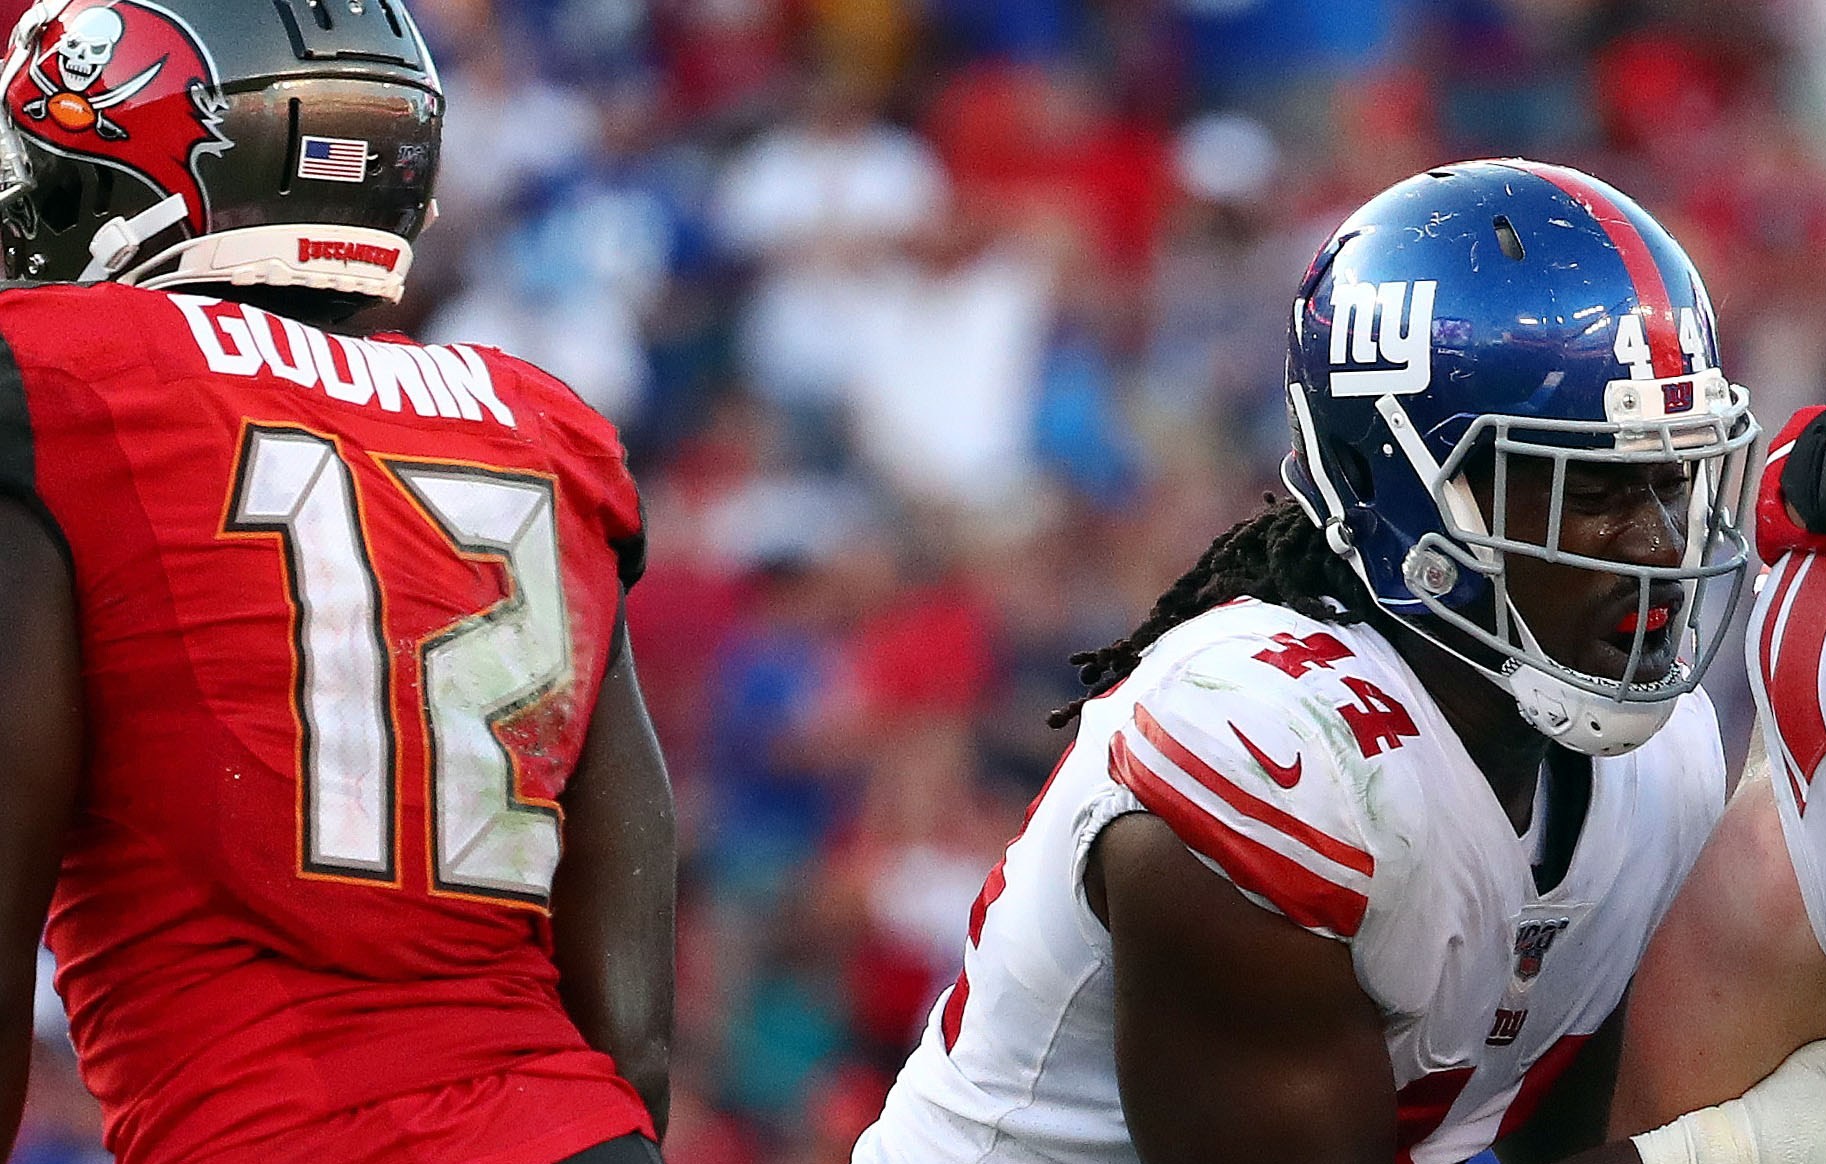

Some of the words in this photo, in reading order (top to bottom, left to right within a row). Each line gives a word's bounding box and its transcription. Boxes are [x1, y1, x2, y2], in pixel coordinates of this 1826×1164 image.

[168, 294, 516, 427] GODWIN
[1328, 280, 1437, 397] ny
[215, 415, 572, 917] 12
